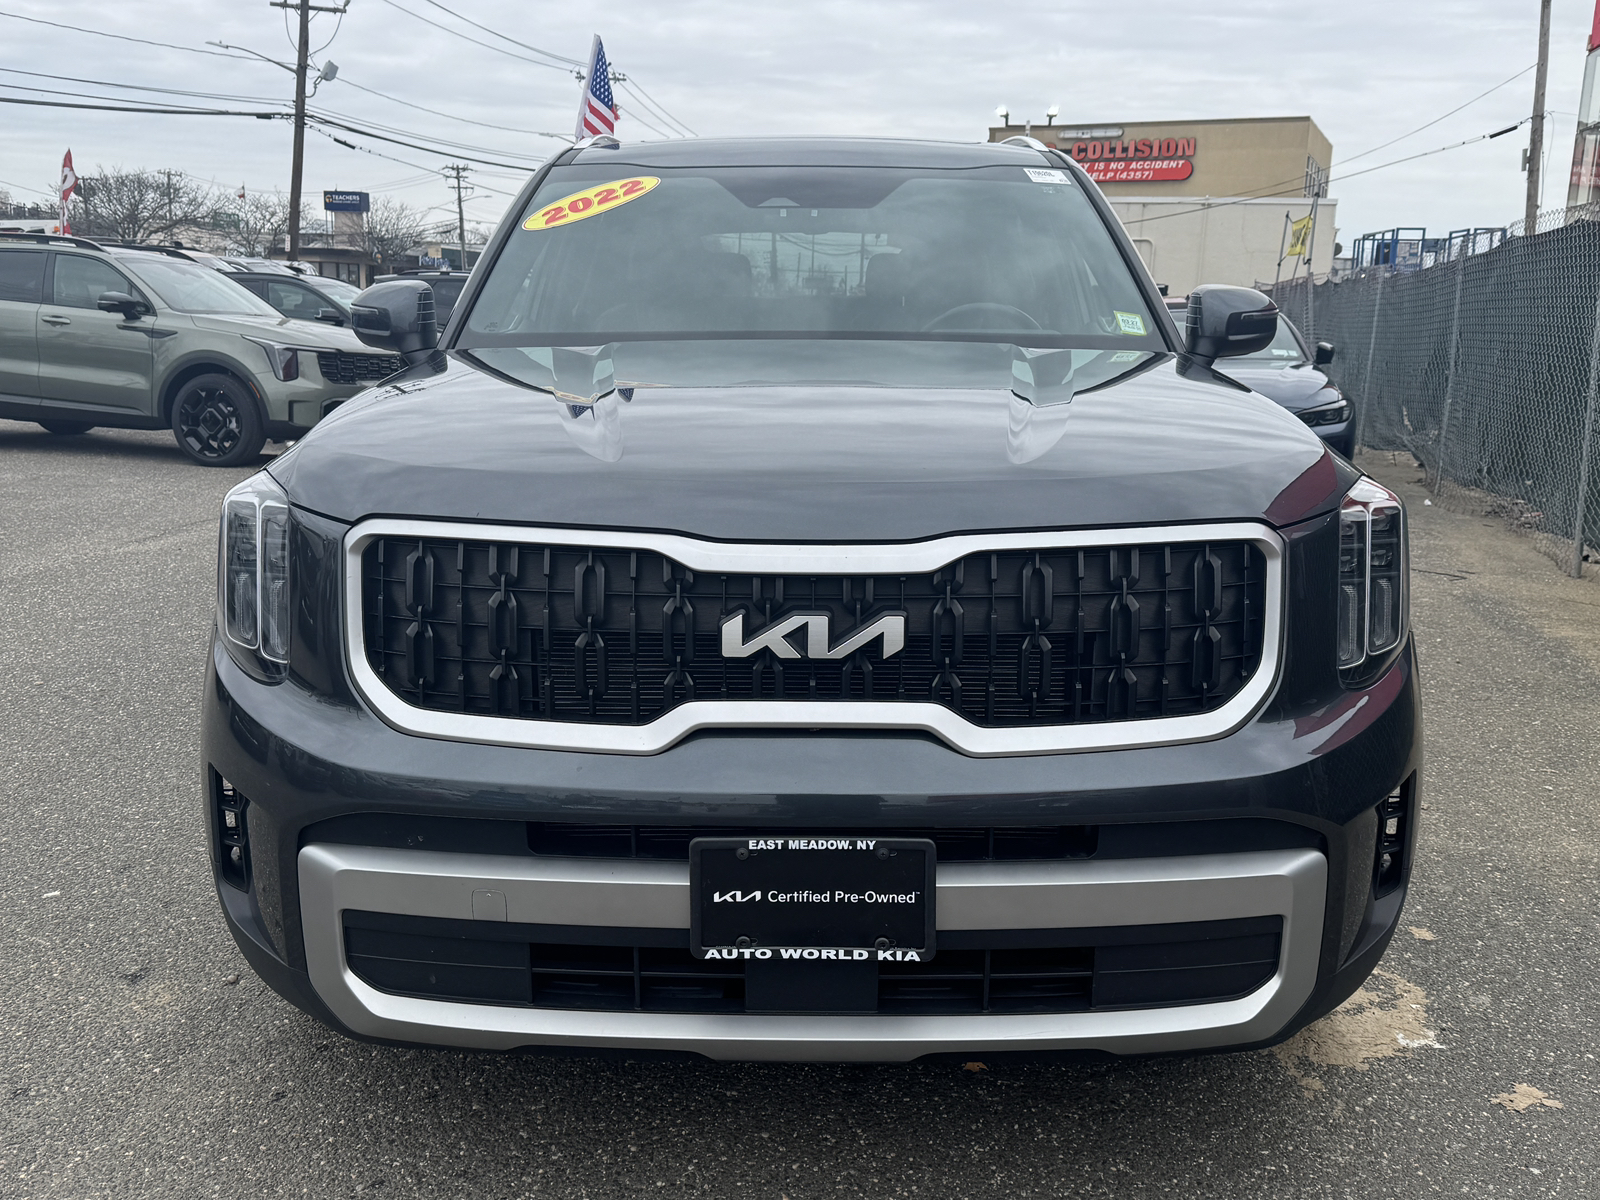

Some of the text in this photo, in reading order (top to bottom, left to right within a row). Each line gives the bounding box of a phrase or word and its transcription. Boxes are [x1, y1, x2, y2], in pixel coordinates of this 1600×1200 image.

[1072, 138, 1196, 160] COLLISION
[1094, 162, 1106, 170] IS
[1109, 161, 1126, 170] NO
[1129, 160, 1186, 170] ACCIDENT
[1116, 170, 1154, 180] (4357)
[541, 179, 647, 226] 2022
[748, 839, 785, 850] EAST
[856, 839, 877, 850] NY
[767, 890, 830, 903] Certified
[704, 948, 921, 962] AUTO WORLD KIA
